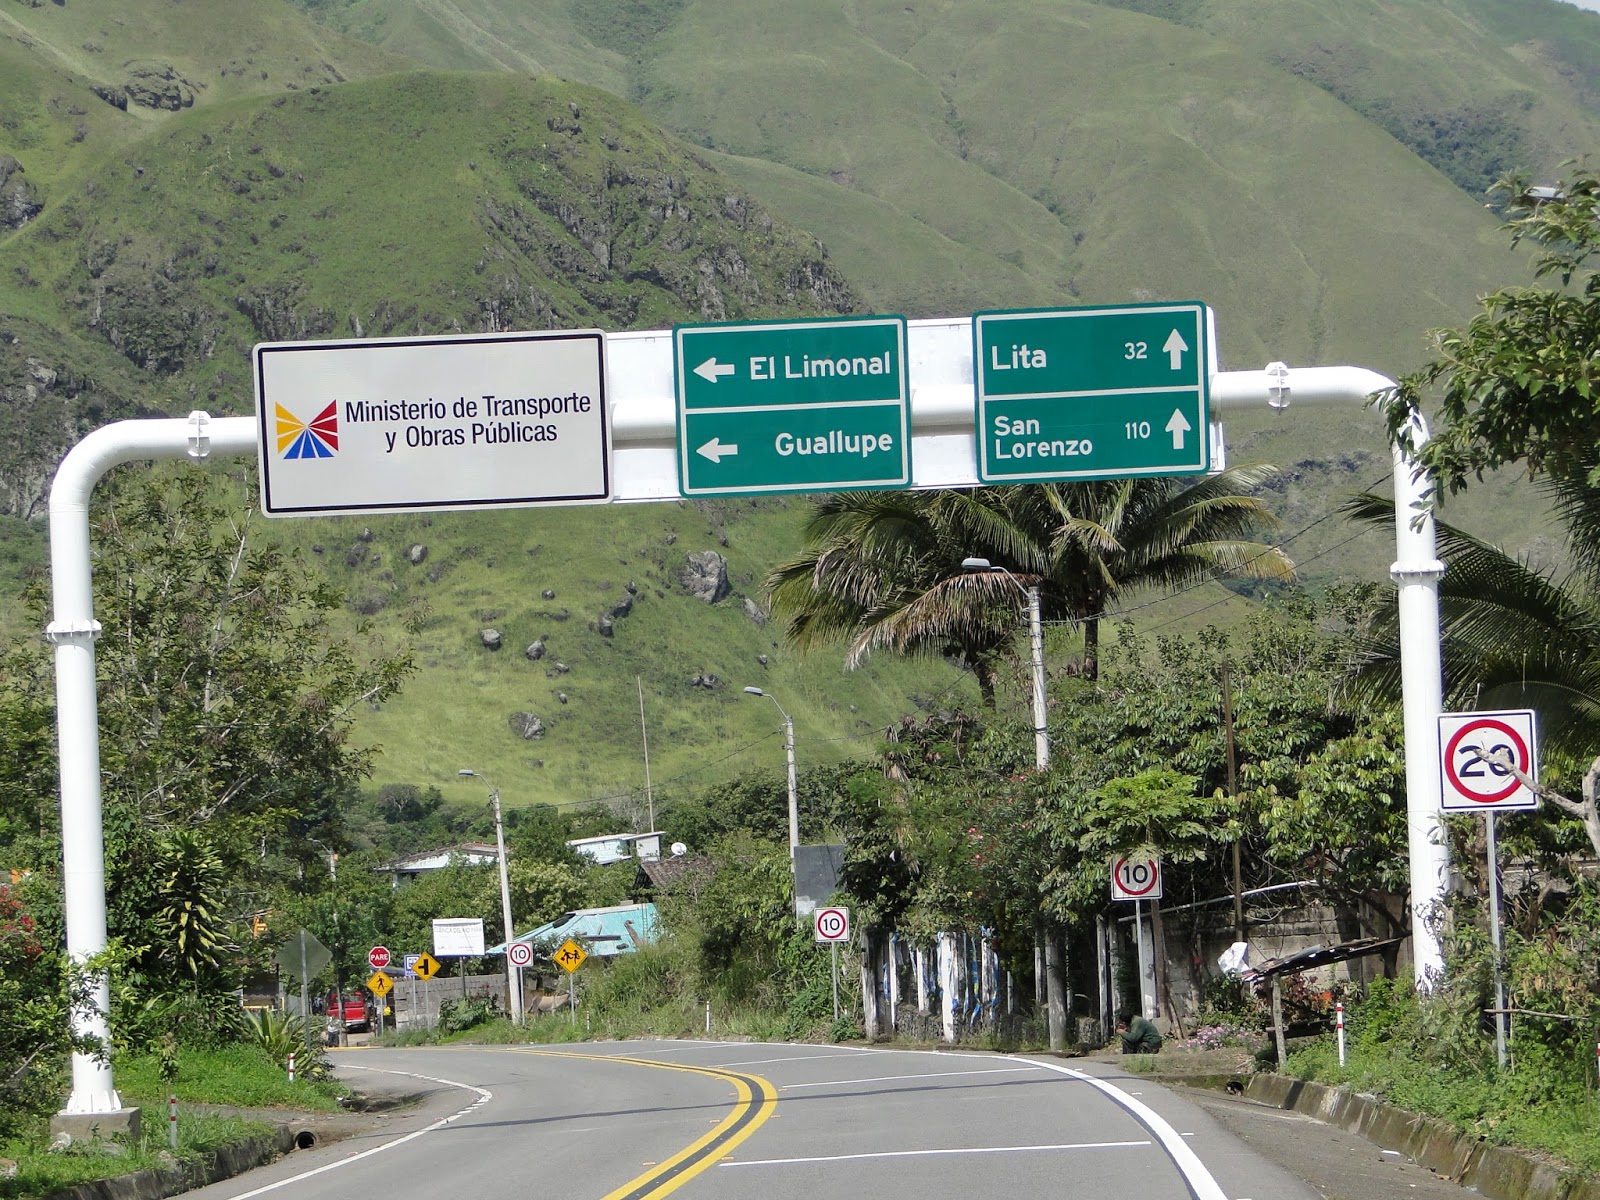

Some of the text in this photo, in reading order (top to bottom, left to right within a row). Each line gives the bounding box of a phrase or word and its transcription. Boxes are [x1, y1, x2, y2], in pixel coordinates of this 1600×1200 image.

[749, 351, 891, 380] El Limonal
[991, 341, 1148, 370] Lita 32
[345, 392, 591, 423] Ministerio de Transporte
[994, 415, 1040, 436] San
[1125, 421, 1151, 440] 110
[385, 421, 558, 453] y Obras Públicas
[775, 430, 893, 458] Guallupe
[995, 439, 1093, 460] Lorenzo
[1123, 864, 1149, 884] 10
[823, 917, 841, 931] 10
[370, 953, 389, 961] PARE
[514, 949, 527, 960] 10
